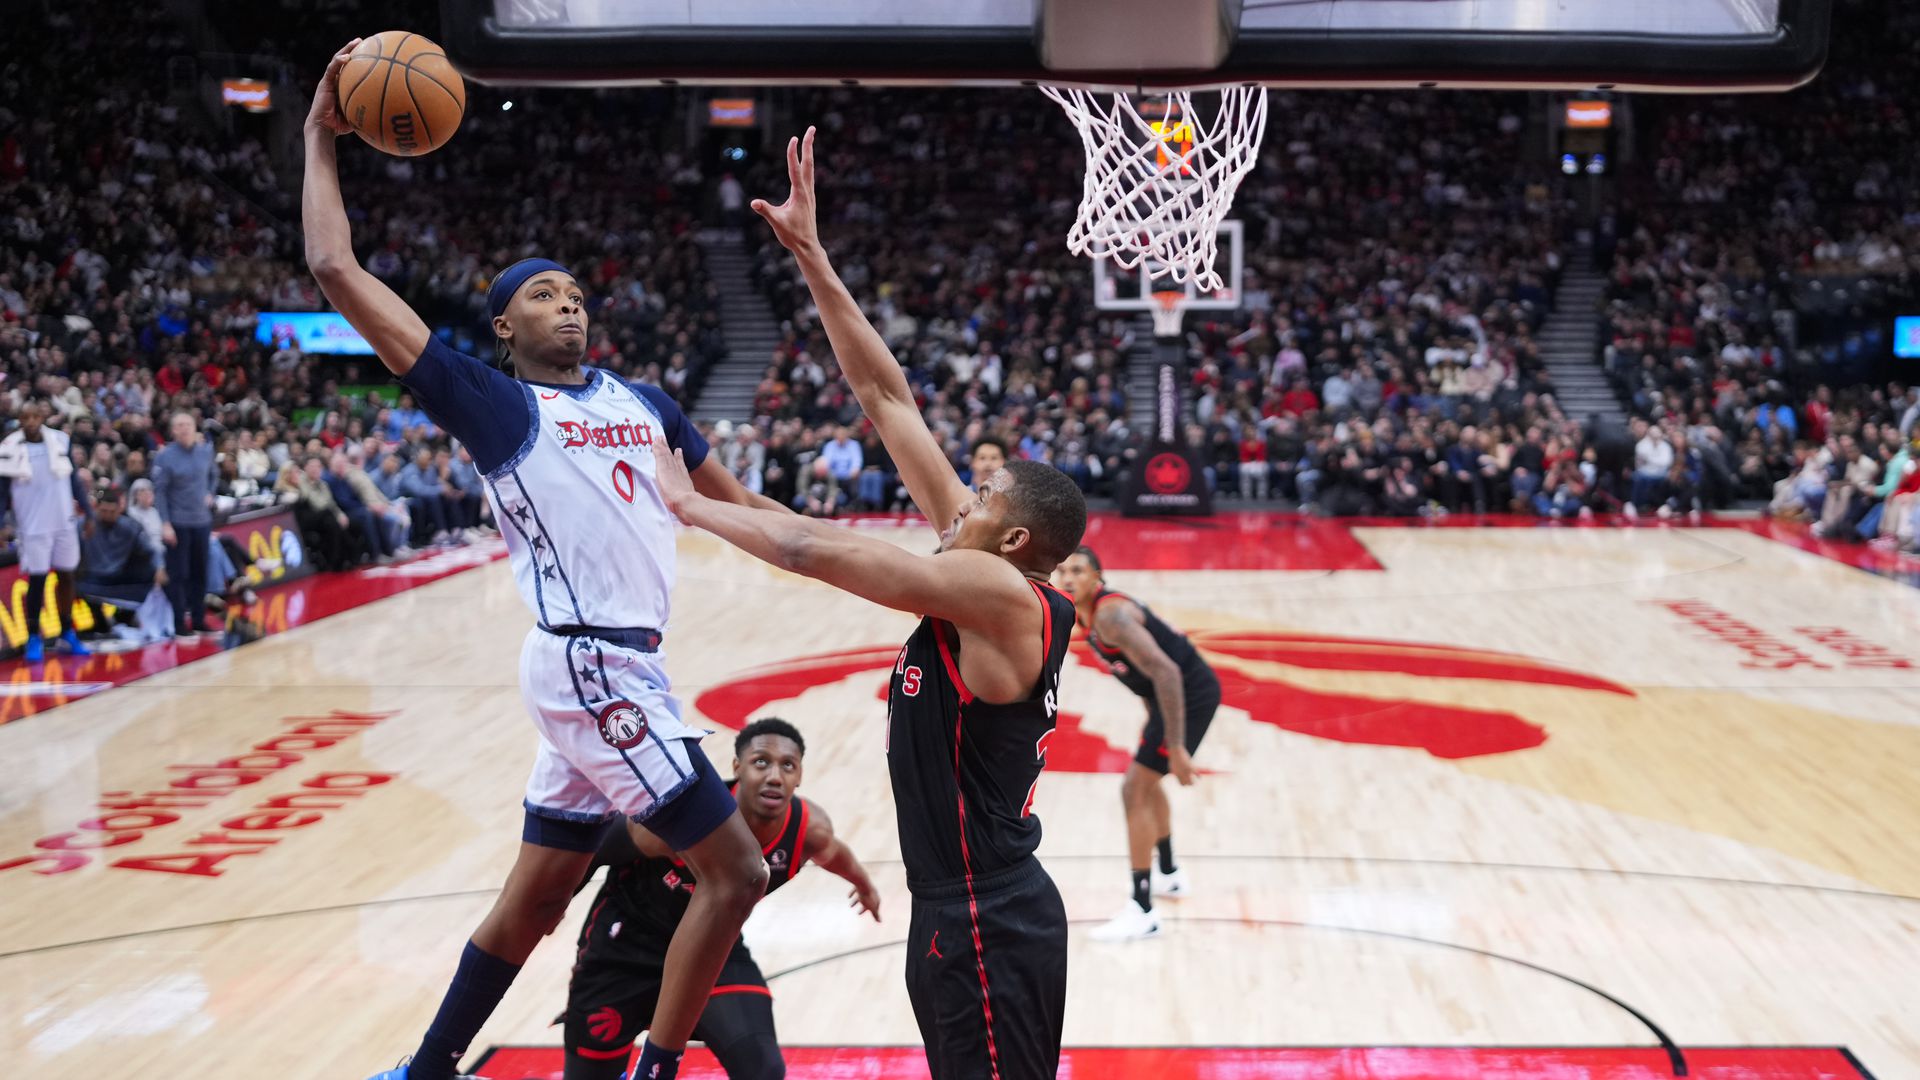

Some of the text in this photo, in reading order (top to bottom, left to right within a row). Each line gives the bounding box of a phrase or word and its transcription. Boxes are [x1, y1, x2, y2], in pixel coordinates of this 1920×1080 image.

[555, 417, 653, 449] District
[612, 460, 636, 504] 0
[0, 709, 403, 875] Scotiabank
[108, 771, 399, 877] Arena
